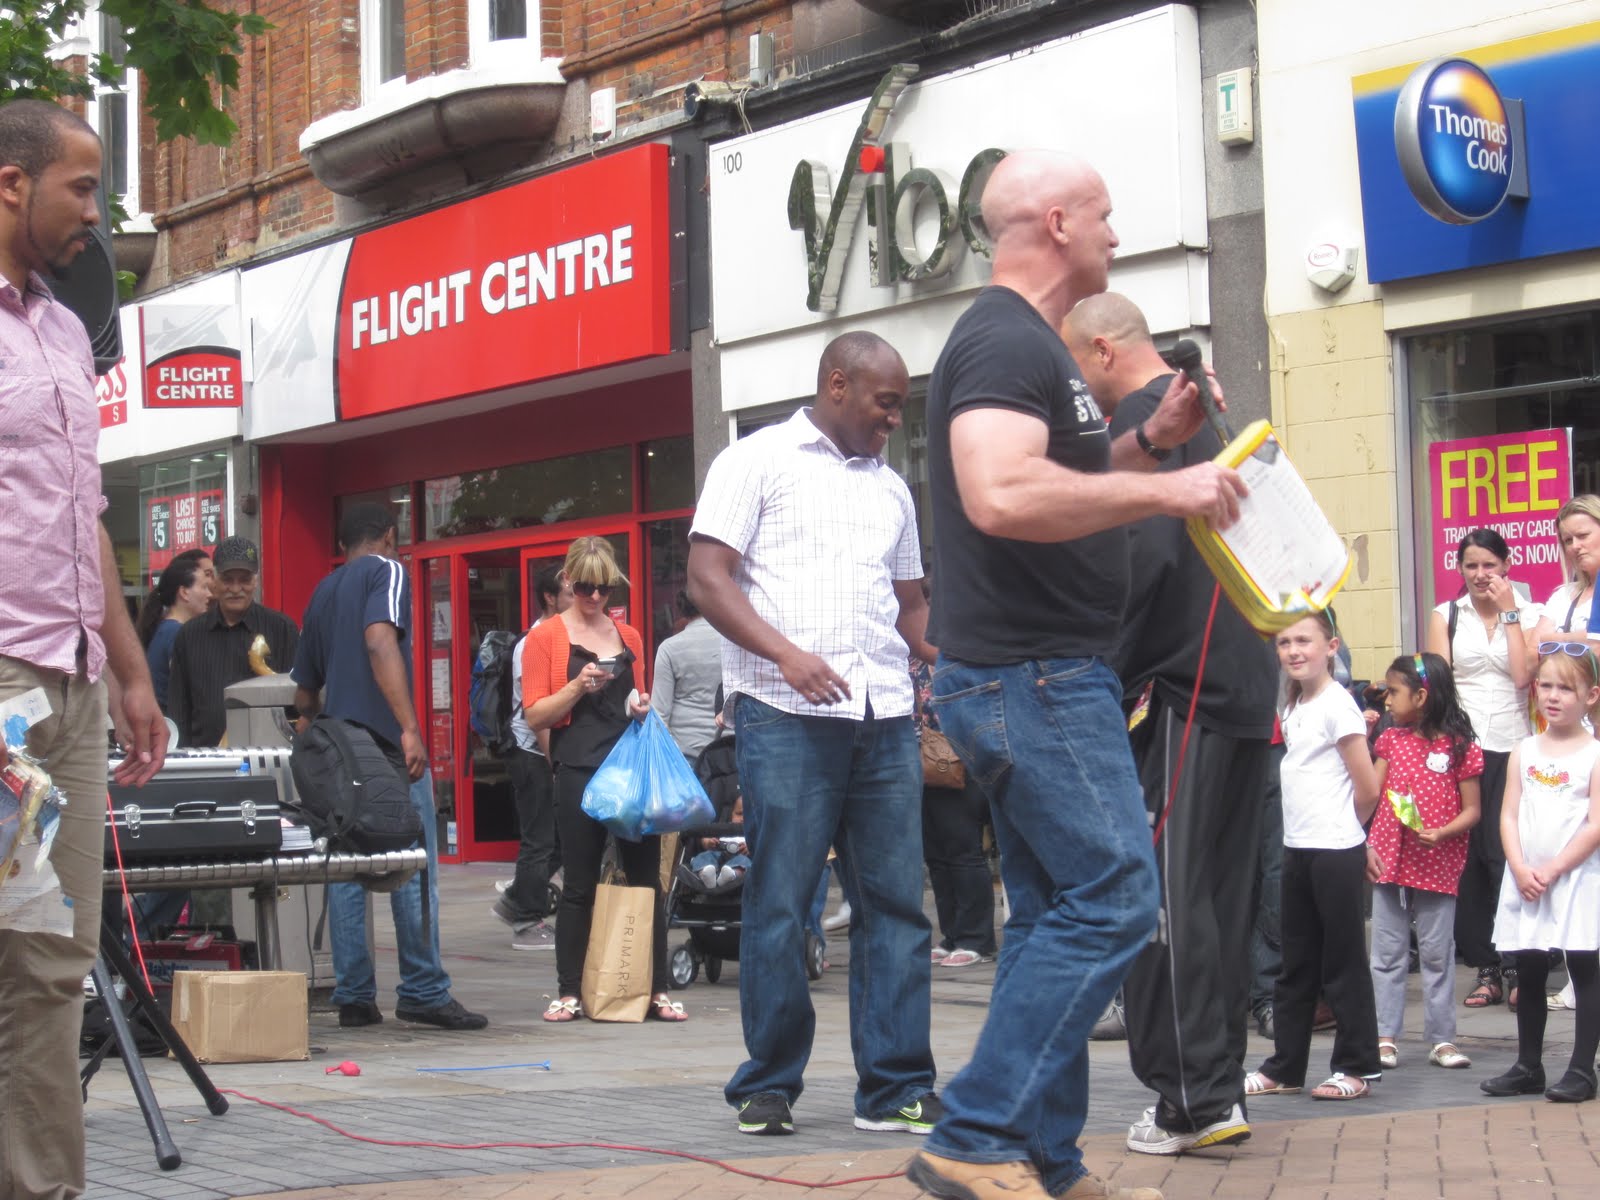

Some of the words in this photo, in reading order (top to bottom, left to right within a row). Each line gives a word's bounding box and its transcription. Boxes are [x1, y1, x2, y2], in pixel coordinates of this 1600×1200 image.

[1428, 104, 1508, 146] Thomas
[723, 151, 743, 176] 100
[1466, 140, 1508, 176] Cook
[352, 270, 471, 351] FLIGHT
[480, 224, 633, 316] CENTRE
[159, 366, 231, 382] FLIGHT
[156, 384, 235, 400] CENTRE
[1441, 441, 1560, 519] FREE
[175, 497, 195, 517] LAST
[176, 531, 184, 544] TO
[185, 530, 195, 543] BUY
[618, 915, 635, 995] PRIMARK
